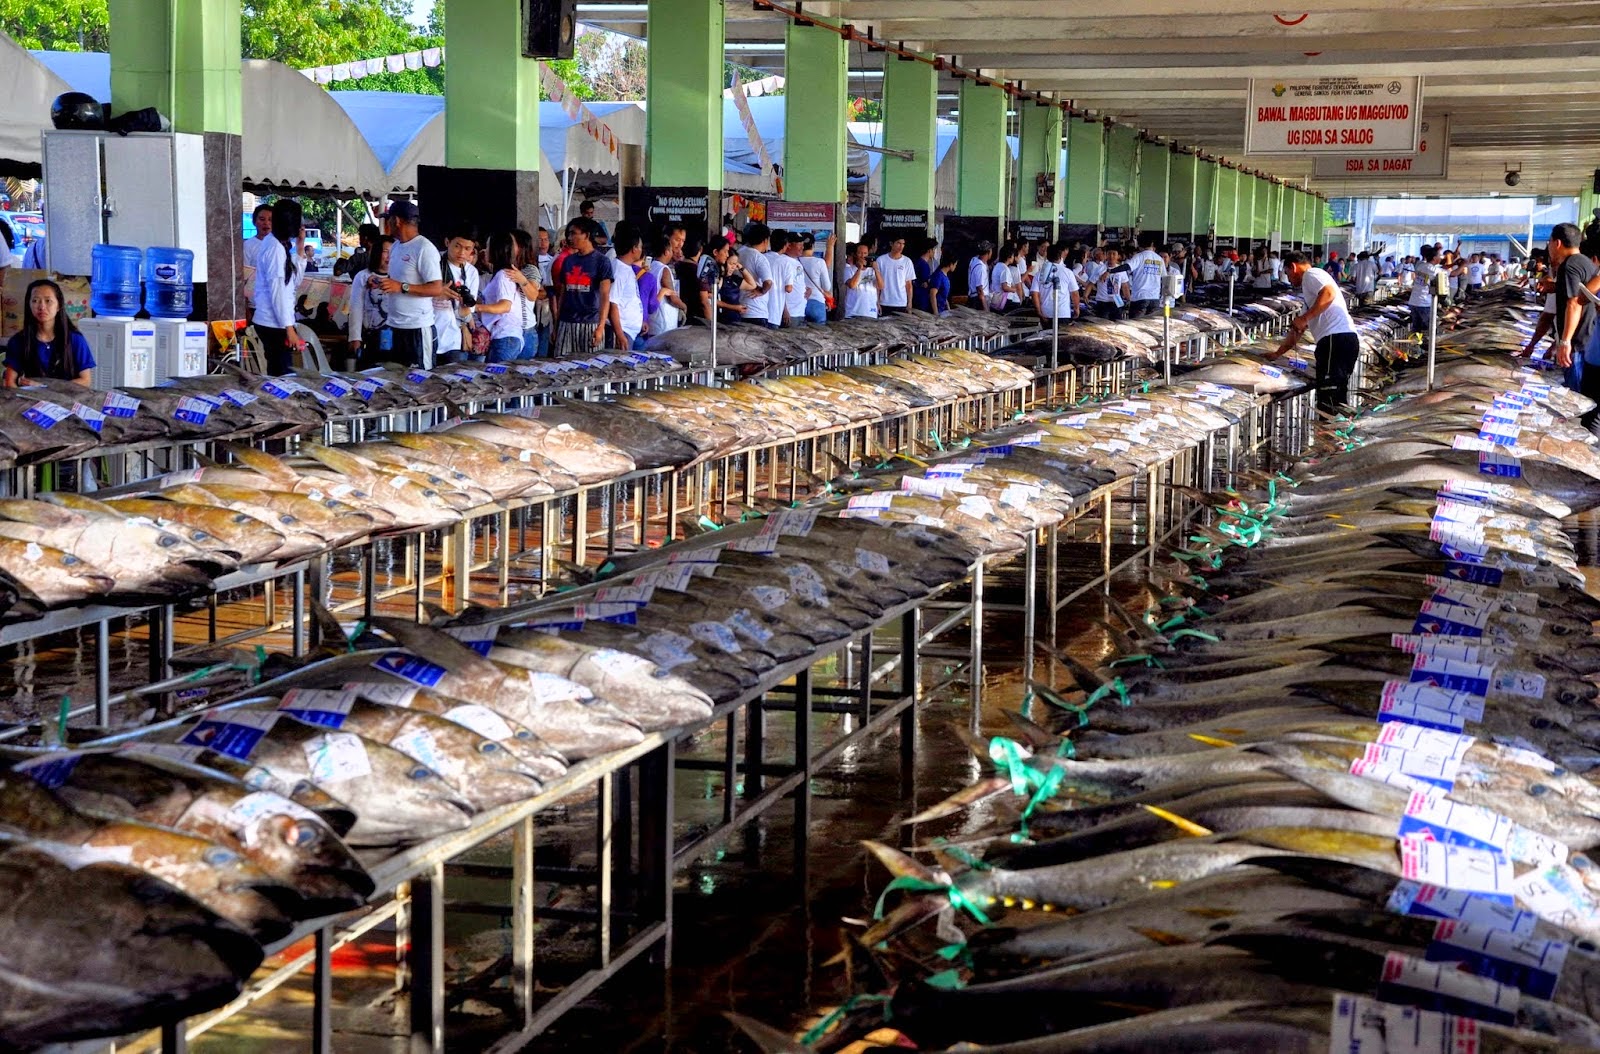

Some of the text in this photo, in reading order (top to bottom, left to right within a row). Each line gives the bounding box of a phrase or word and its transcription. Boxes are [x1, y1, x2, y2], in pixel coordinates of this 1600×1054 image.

[1258, 104, 1409, 121] BAWAL MAGBUTANG UG MAGGUYOD
[1287, 128, 1374, 145] UG ISDA SA SALOG
[1345, 158, 1413, 171] ISDA SA DAGAT
[668, 197, 683, 207] FOOD
